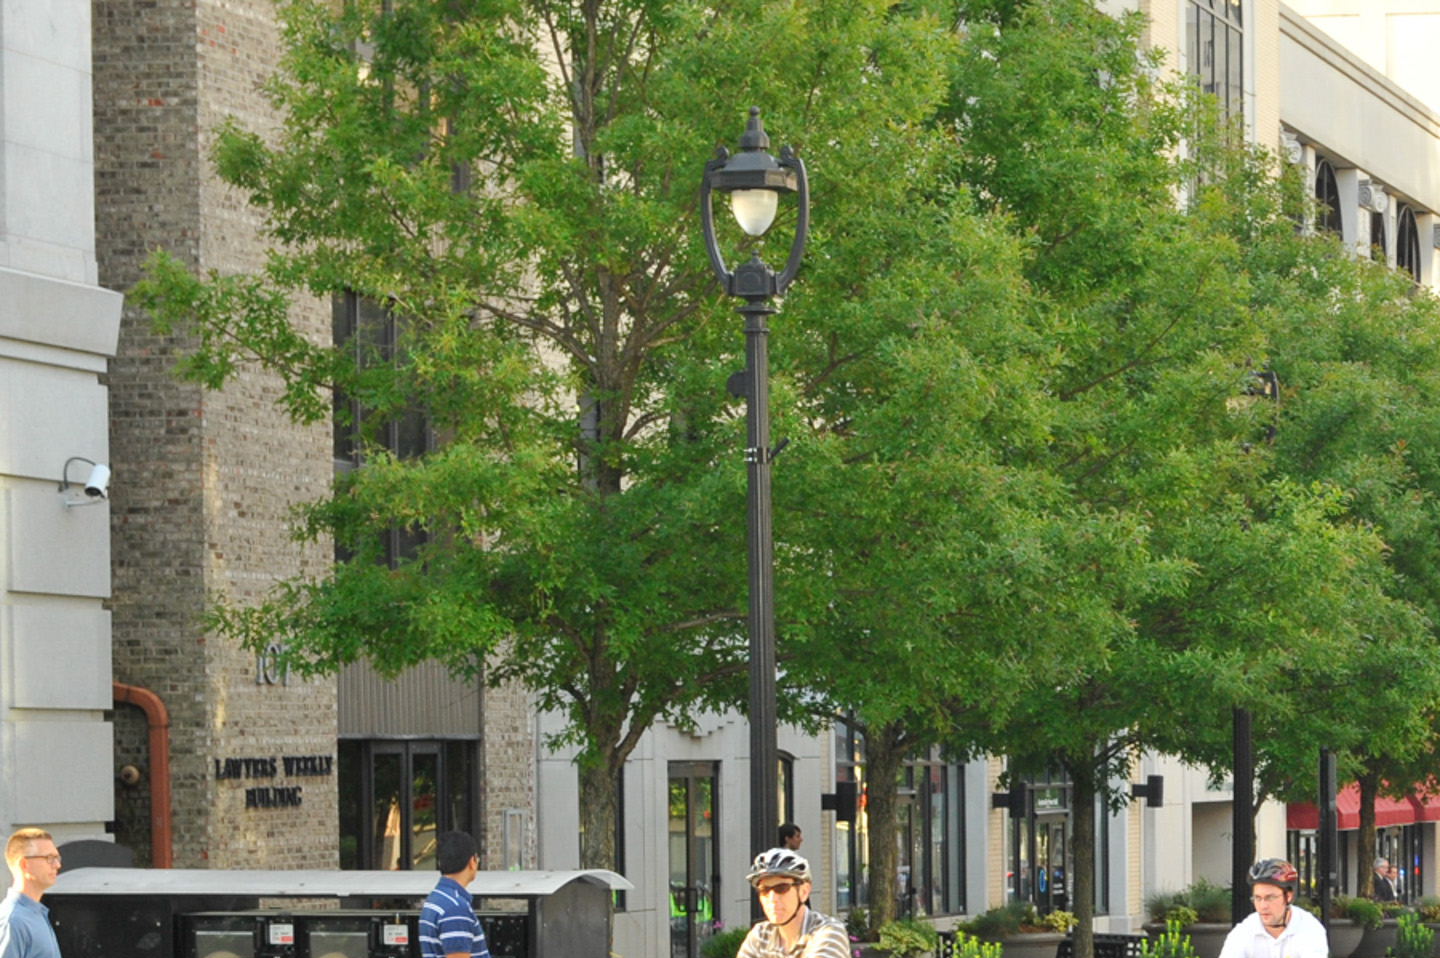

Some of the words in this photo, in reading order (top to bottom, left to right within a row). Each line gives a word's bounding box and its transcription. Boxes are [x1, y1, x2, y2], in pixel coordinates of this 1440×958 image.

[215, 757, 277, 779] LAWYERS
[282, 755, 332, 776] WEEKLY
[245, 786, 302, 808] BUILDING
